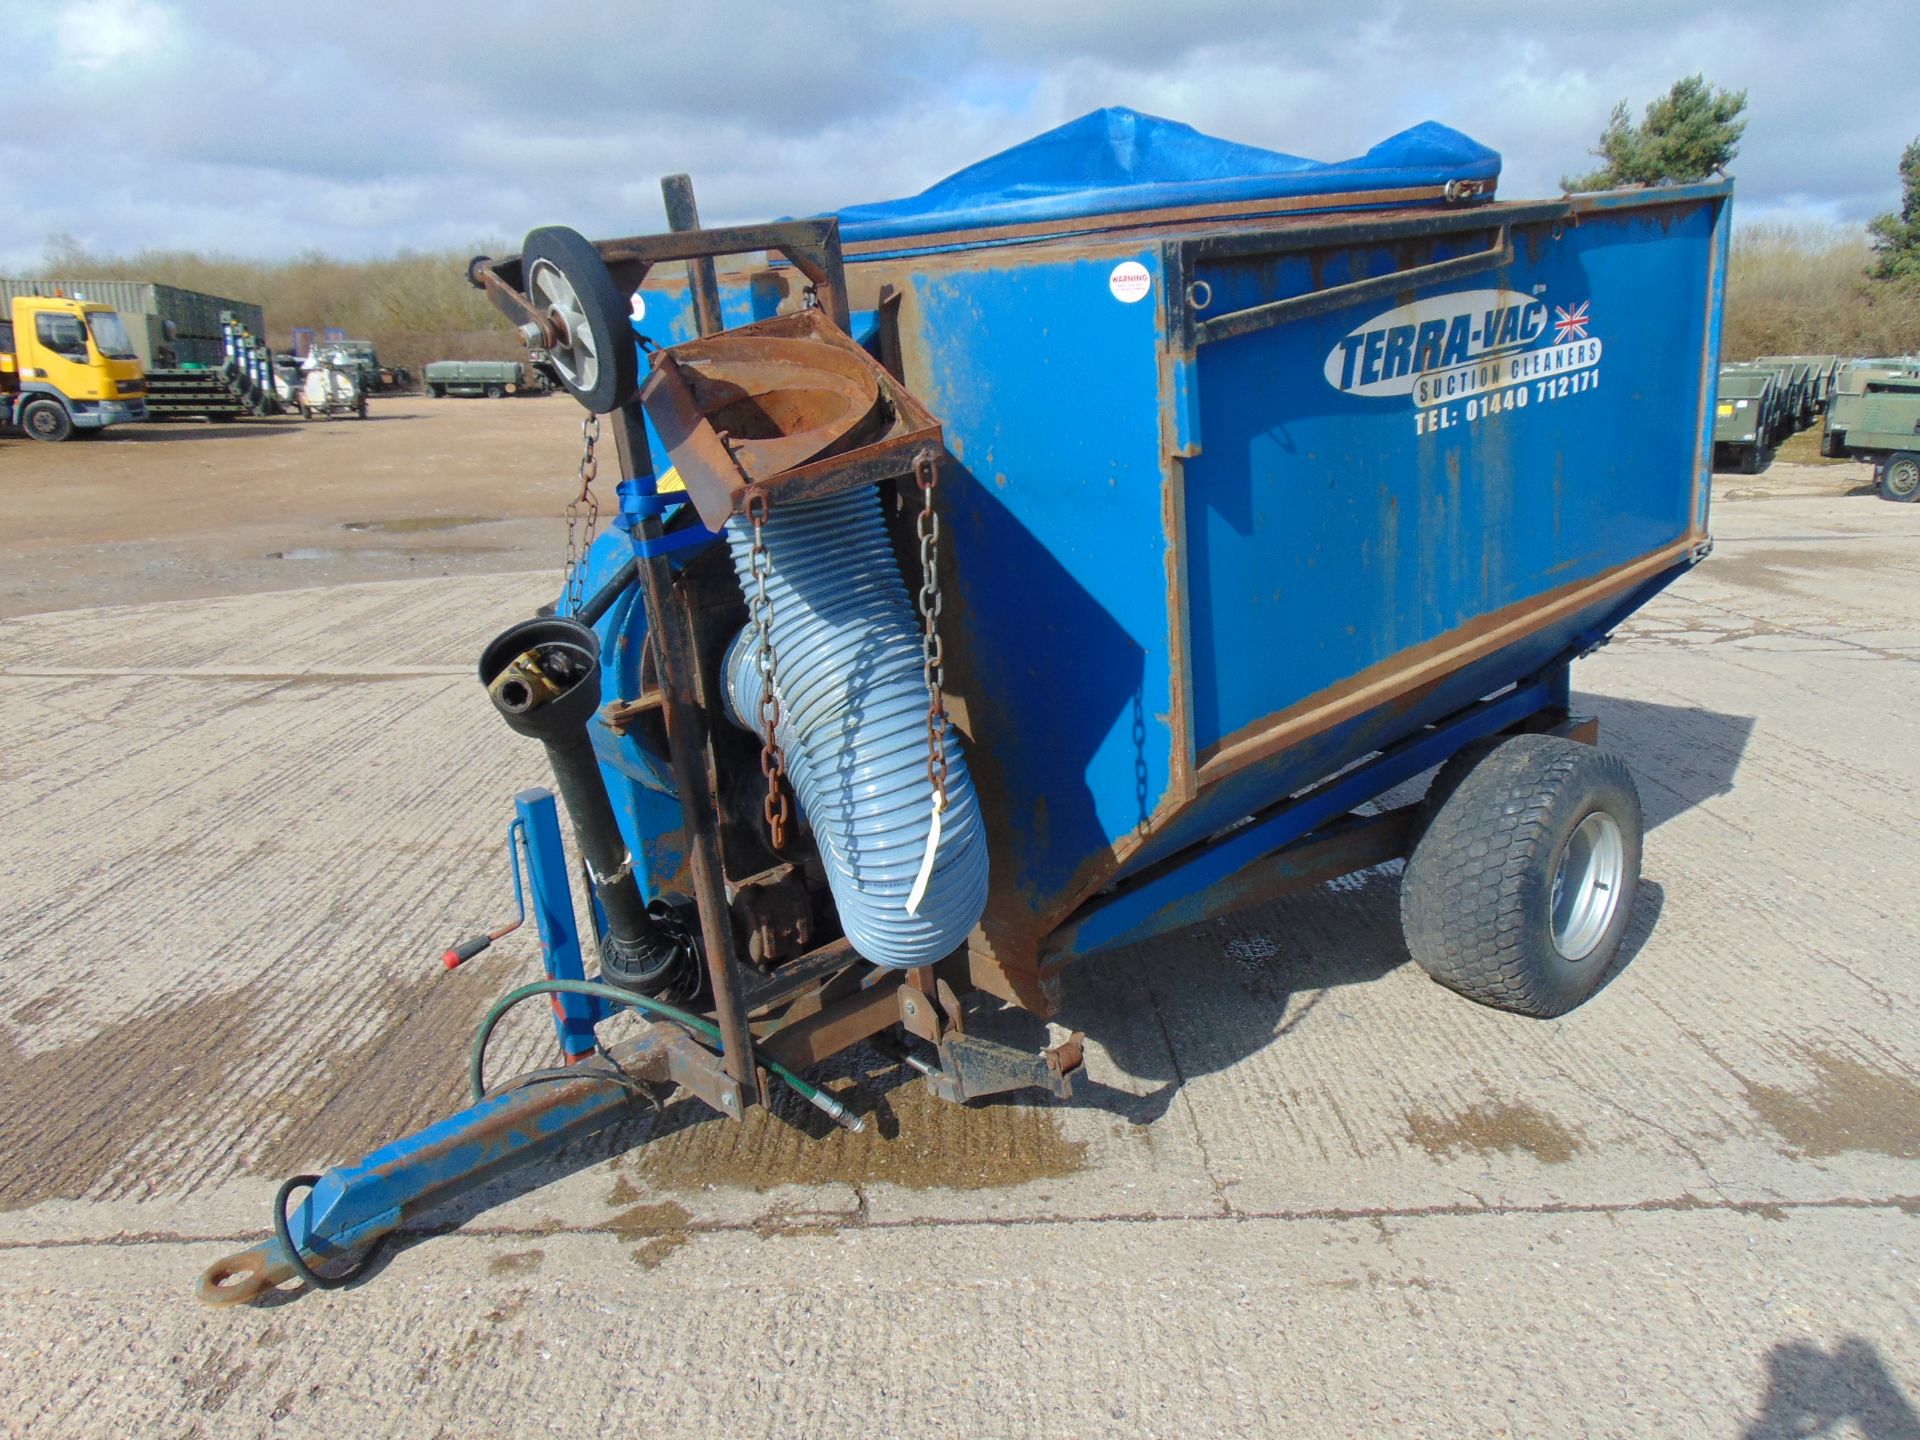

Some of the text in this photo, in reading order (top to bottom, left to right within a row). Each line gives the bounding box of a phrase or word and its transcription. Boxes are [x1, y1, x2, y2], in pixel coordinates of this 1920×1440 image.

[1112, 274, 1148, 283] WARNING
[1339, 301, 1544, 391] TERRA-VAC
[1420, 342, 1597, 402] SUCTION CLEANERS
[1414, 369, 1599, 435] TEL: 01440 712171
